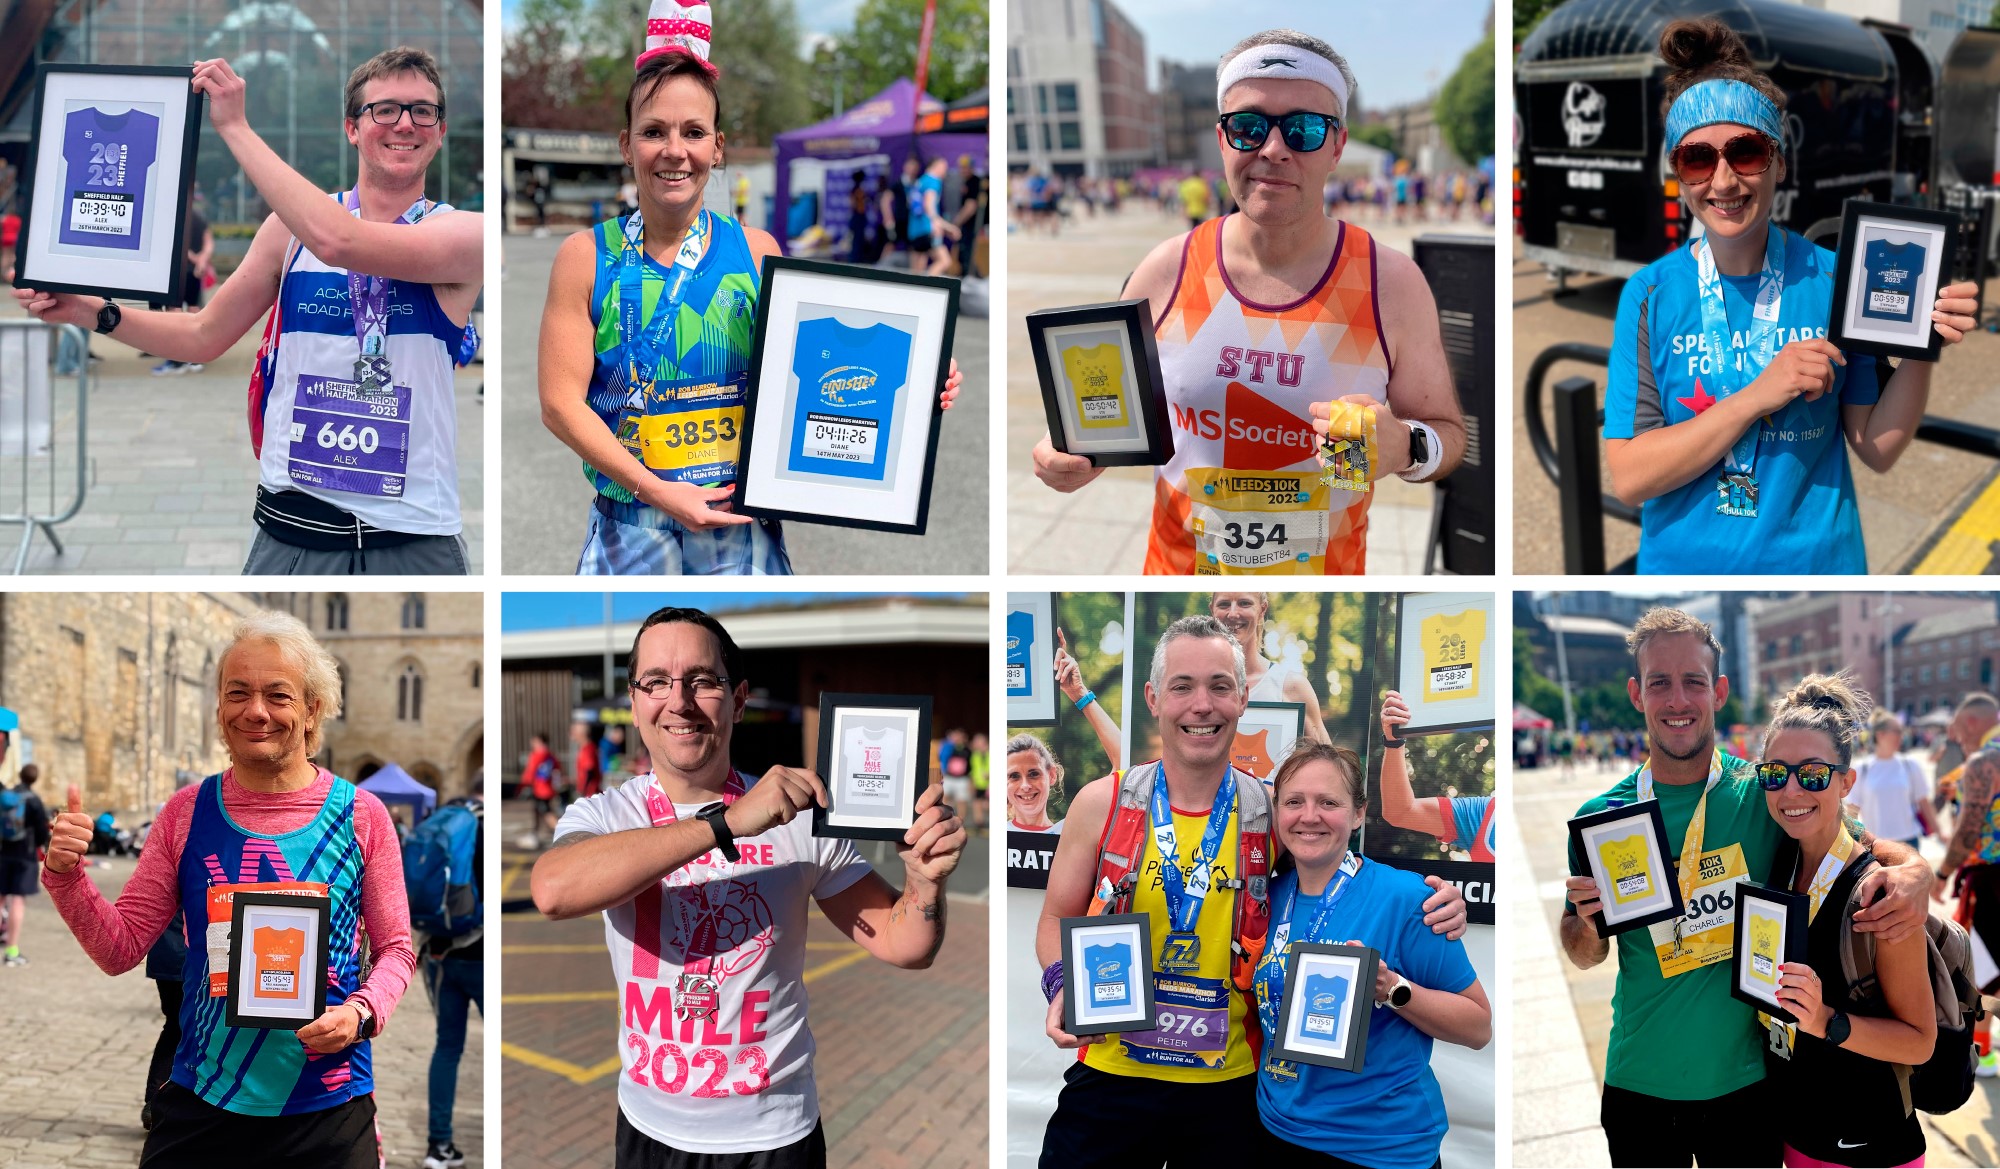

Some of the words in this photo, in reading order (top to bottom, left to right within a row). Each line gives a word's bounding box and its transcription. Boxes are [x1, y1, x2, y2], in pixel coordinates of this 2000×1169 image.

[89, 142, 121, 165] 20
[117, 144, 128, 187] SHEFFIELD
[86, 164, 119, 187] 23
[83, 192, 110, 200] SHEFFIELD
[79, 201, 126, 217] 01:39:40
[1884, 276, 1901, 285] 2023
[1764, 285, 1776, 317] FINISHER
[297, 302, 341, 317] ROAD
[1672, 330, 1750, 355] SPEA
[1776, 326, 1825, 348] TARS
[1216, 345, 1305, 388] STU
[326, 381, 357, 393] SHEFFIE
[691, 382, 718, 392] BURROW
[698, 385, 738, 398] MARATHON
[821, 375, 877, 395] FINISHER
[326, 390, 347, 399] HALF
[348, 391, 398, 406] MARATHON
[716, 392, 739, 401] Clarion
[369, 404, 398, 418] 2023
[665, 416, 737, 449] 3853
[816, 425, 867, 444] 04:11:26
[1173, 401, 1223, 441] MS
[1228, 417, 1317, 455] Society
[317, 421, 379, 454] 660
[644, 438, 651, 447] S
[1779, 430, 1798, 442] NO:
[687, 448, 718, 460] DIANE
[830, 443, 849, 451] DIANE
[333, 455, 359, 467] ALEX
[816, 450, 831, 458] 14TH
[831, 451, 845, 459] MAY
[845, 452, 860, 461] 2023
[692, 472, 707, 480] RUN
[707, 470, 721, 478] FOR
[1233, 479, 1272, 491] LEEDS
[1273, 479, 1299, 491] 10K
[1331, 480, 1353, 490] LEEDS
[1267, 493, 1300, 505] 2023
[1224, 522, 1289, 550] 354
[1221, 549, 1291, 566] @STUBERT84
[864, 761, 882, 769] MILE
[1701, 857, 1722, 869] 10K
[1700, 866, 1726, 881] 2023
[1682, 889, 1735, 921] 306
[1688, 915, 1725, 933] CHARLIE
[699, 920, 712, 952] FINISHER
[1661, 954, 1674, 963] RUN
[1159, 984, 1179, 993] LEEDS
[1178, 986, 1217, 997] MARATHON
[1194, 994, 1216, 1003] Clarion
[1156, 1012, 1209, 1038] 976
[1157, 1037, 1189, 1048] PETER
[627, 1032, 771, 1098] 2023
